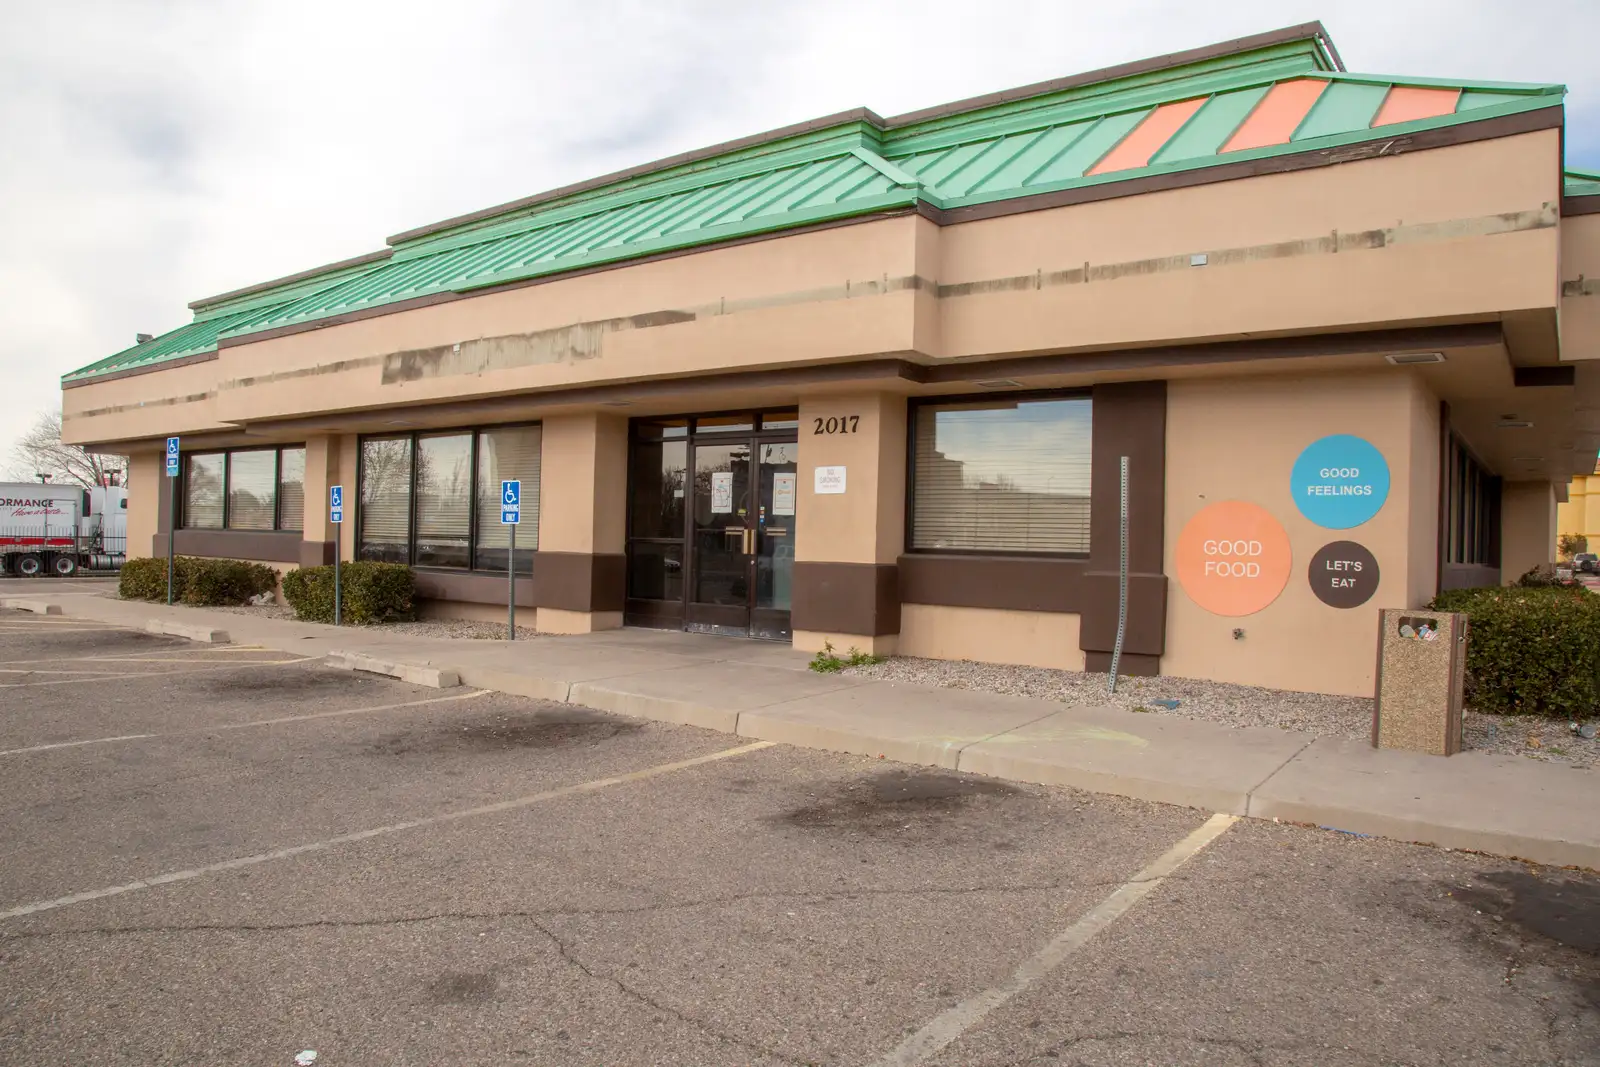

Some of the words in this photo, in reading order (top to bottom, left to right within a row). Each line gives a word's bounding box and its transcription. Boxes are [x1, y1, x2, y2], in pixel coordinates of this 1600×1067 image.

[814, 415, 860, 435] 2017
[1319, 468, 1360, 478] GOOD
[1307, 485, 1372, 496] FEELINGS
[502, 504, 519, 512] PARKING
[505, 513, 516, 521] ONLY
[1204, 540, 1262, 556] GOOD
[1205, 562, 1260, 577] FOOD
[1326, 560, 1363, 572] LET'S
[1331, 578, 1356, 588] EAT
